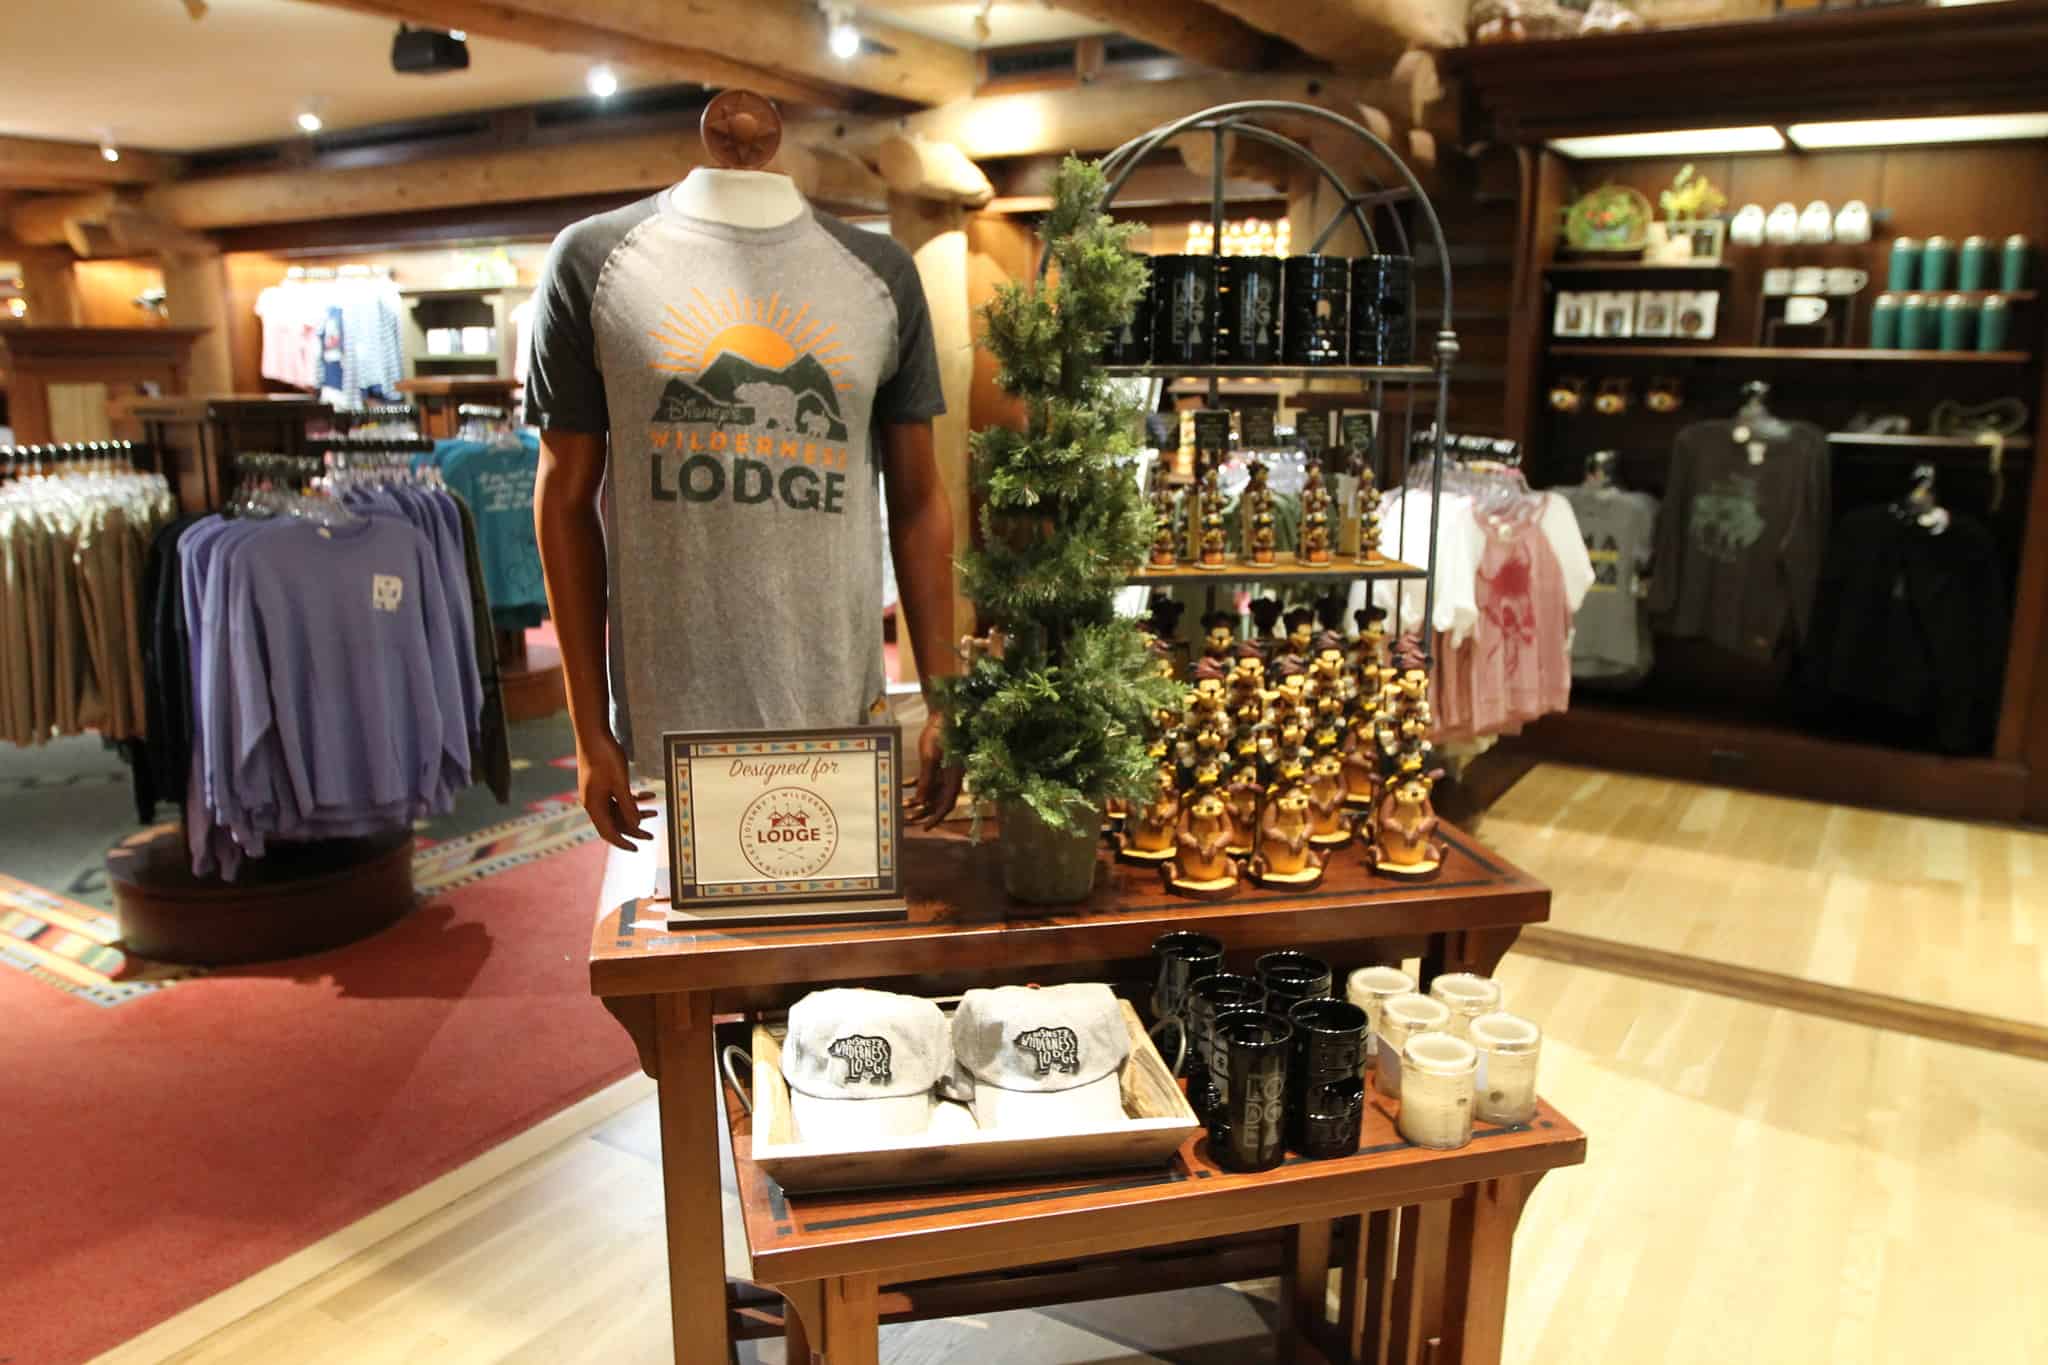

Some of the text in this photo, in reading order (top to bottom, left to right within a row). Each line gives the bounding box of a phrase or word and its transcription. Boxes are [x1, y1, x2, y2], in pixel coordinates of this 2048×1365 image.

[651, 453, 846, 514] LODGE
[729, 757, 838, 785] Designed for
[757, 828, 820, 843] LODGE
[850, 1058, 888, 1077] LODGE
[1039, 1050, 1076, 1069] LODGE
